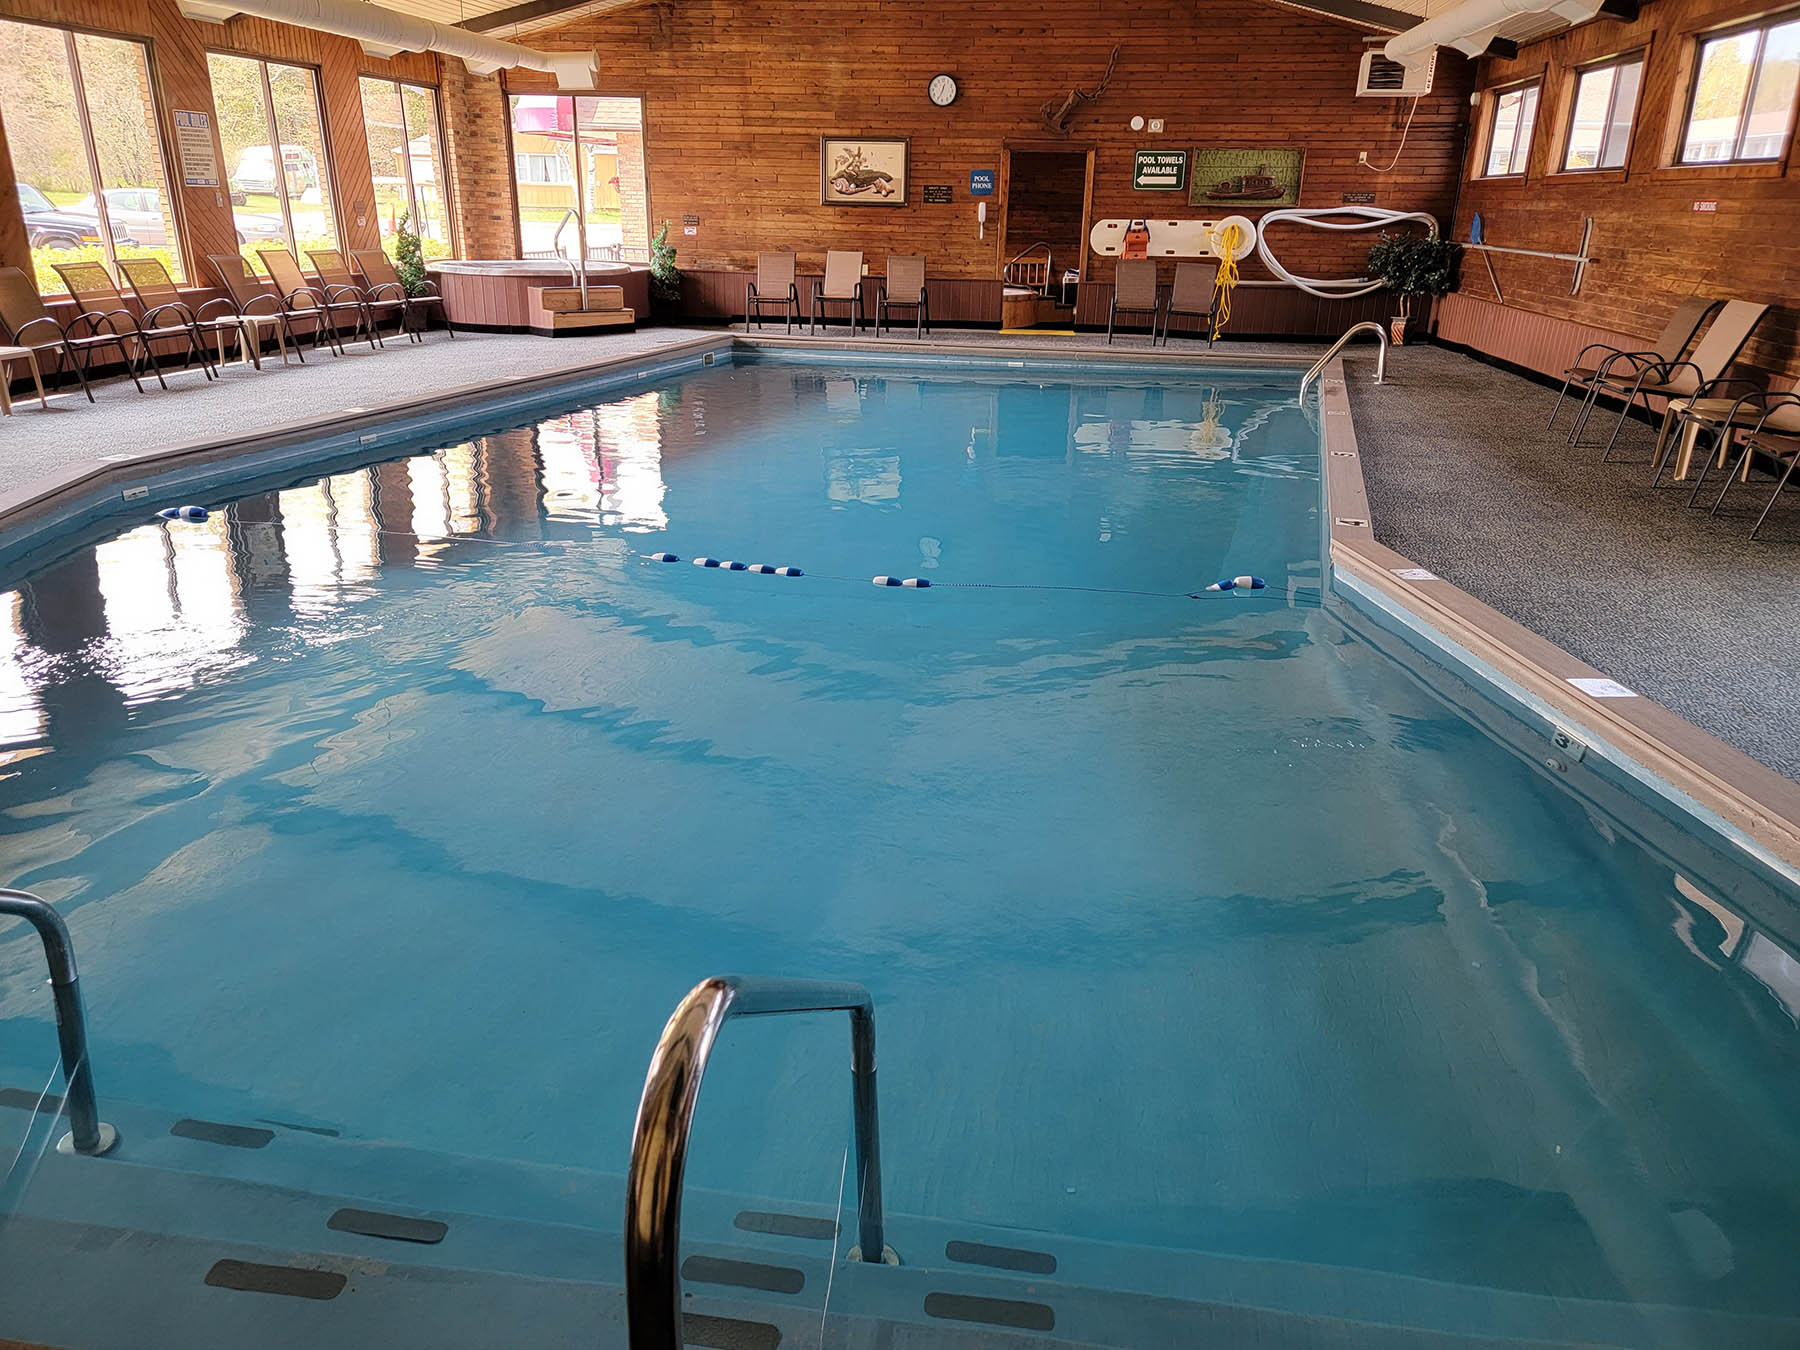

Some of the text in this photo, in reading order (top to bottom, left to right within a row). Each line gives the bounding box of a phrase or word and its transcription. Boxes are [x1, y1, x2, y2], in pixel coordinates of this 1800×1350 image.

[1138, 156, 1184, 164] POOL TOWELS
[1142, 166, 1178, 174] AVAILABLE
[1555, 732, 1570, 749] 3
